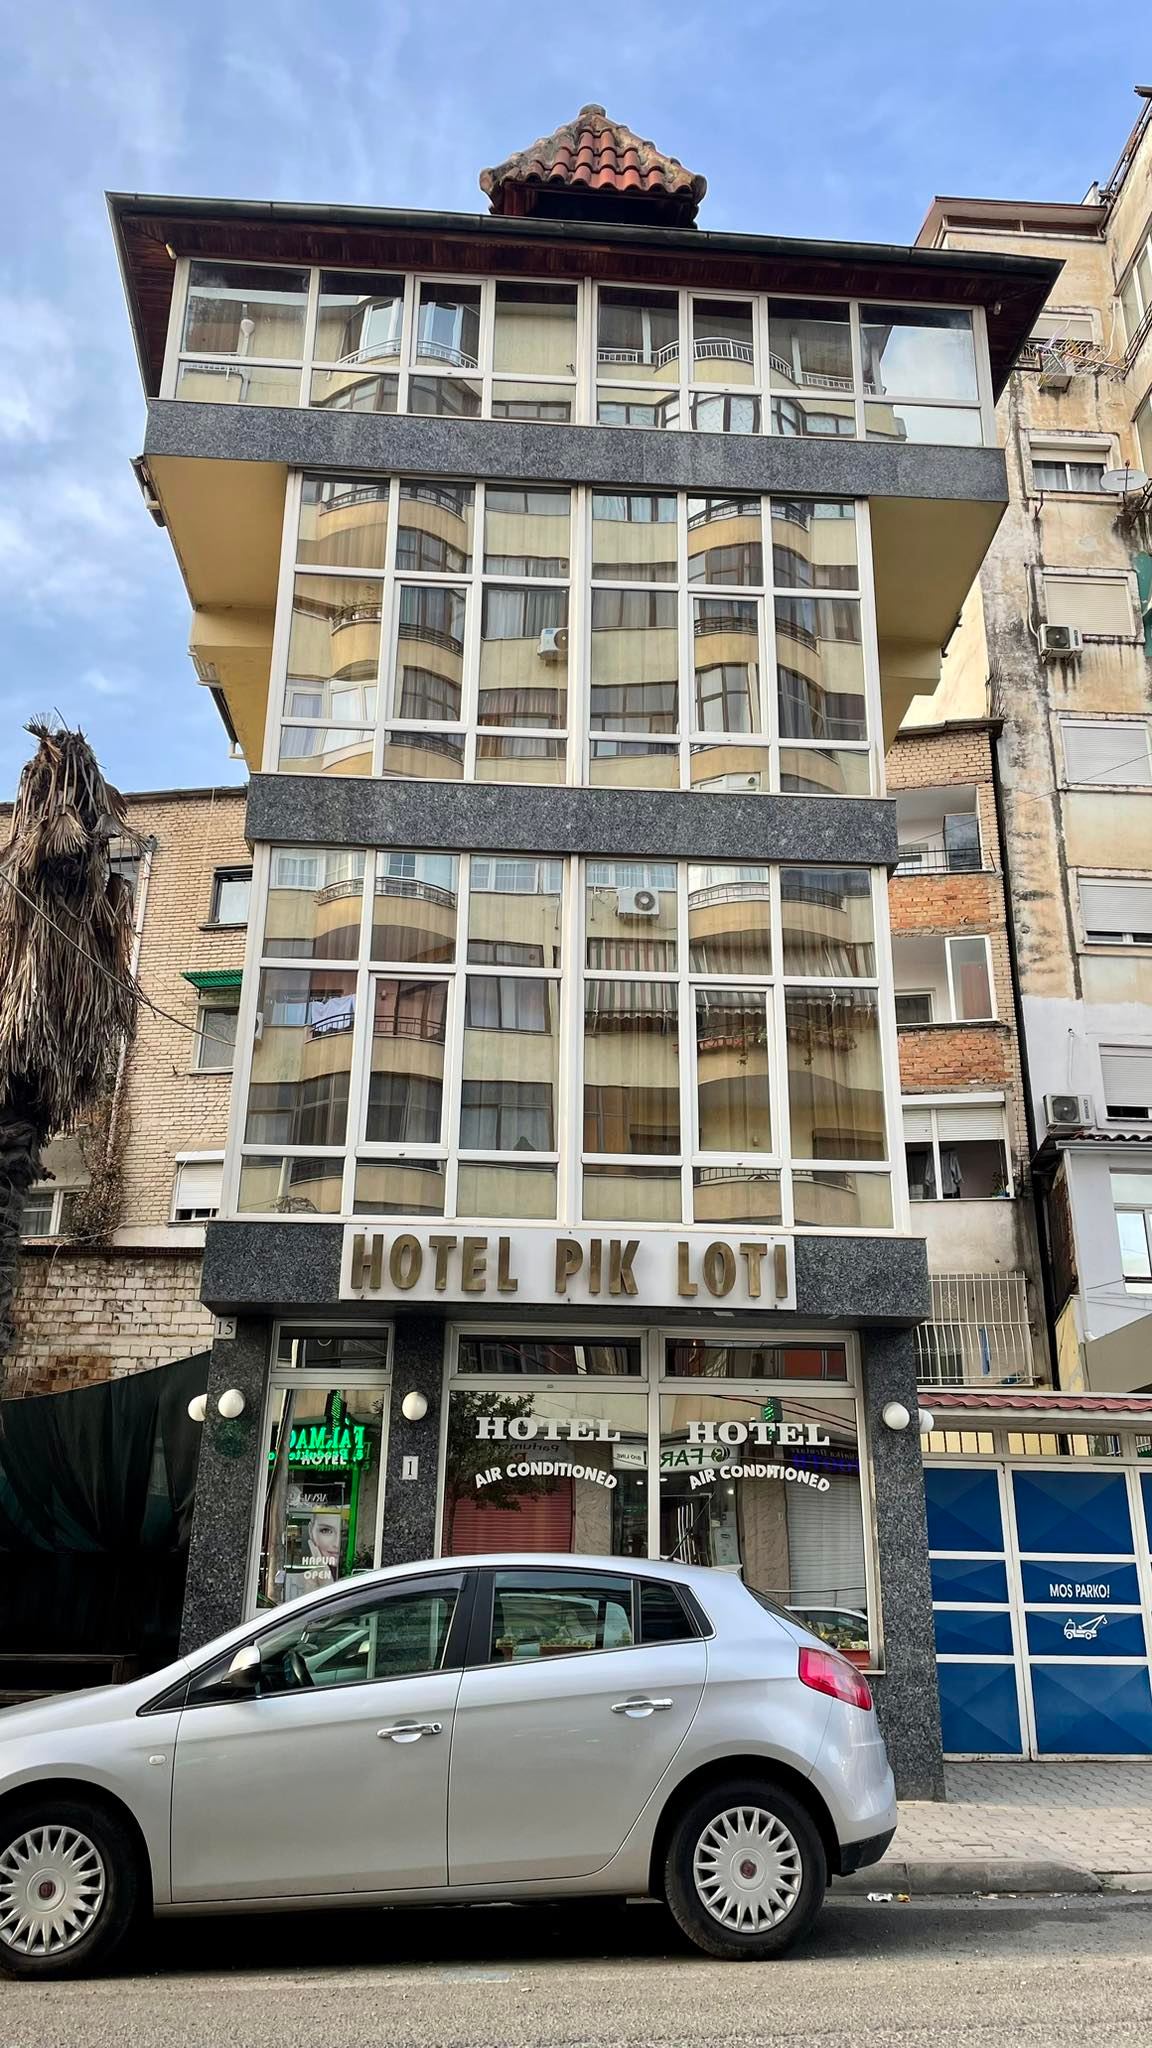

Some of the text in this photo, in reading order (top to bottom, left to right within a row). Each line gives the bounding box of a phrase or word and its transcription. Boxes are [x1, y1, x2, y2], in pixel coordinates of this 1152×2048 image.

[351, 1234, 788, 1299] HOTEL PIK LOTI
[216, 1320, 234, 1336] 15
[475, 1416, 621, 1442] HOTEL
[686, 1420, 831, 1446] HOTEL
[475, 1461, 618, 1489] AIR CONDITIONED
[689, 1468, 717, 1491] AIR
[720, 1463, 831, 1493] CONDITIONED
[303, 1570, 332, 1580] OPEN
[1049, 1583, 1110, 1599] MOS PARKO!
